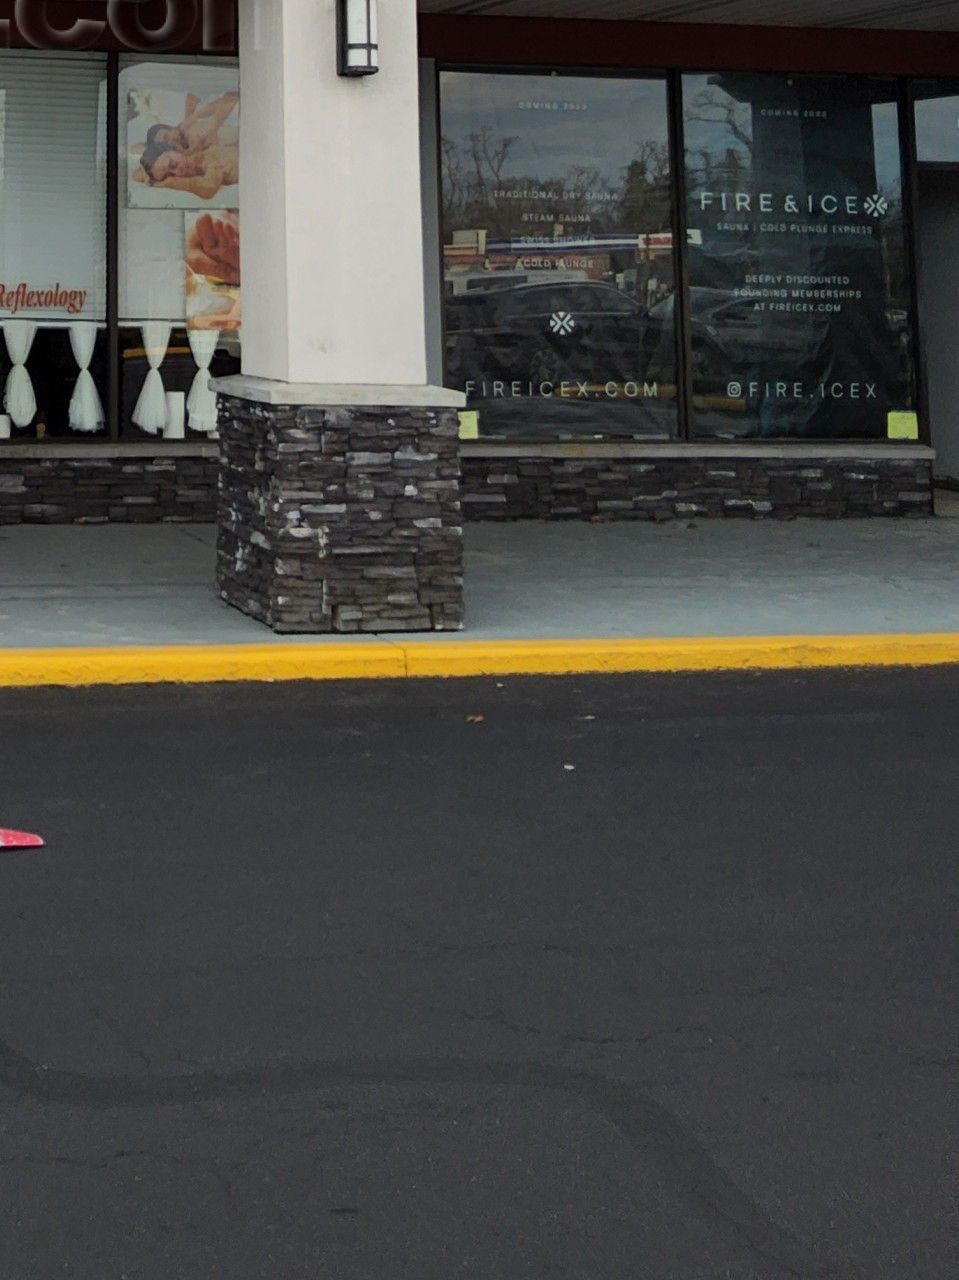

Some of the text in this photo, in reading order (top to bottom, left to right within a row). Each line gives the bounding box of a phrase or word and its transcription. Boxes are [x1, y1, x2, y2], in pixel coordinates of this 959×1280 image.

[493, 190, 618, 201] TRADITIONAL DRY SAUNA
[521, 212, 591, 223] STEAM SAUNA
[716, 222, 873, 235] SAUNA COLD PLUNGE EXPRESS
[523, 259, 551, 268] COLD
[744, 275, 850, 285] DEEPLY DISCOUNTED
[791, 289, 862, 299] MEMBERSHIPS
[753, 303, 841, 312] AT FIREICEX.COM
[464, 380, 659, 398] FIREICEX.COM
